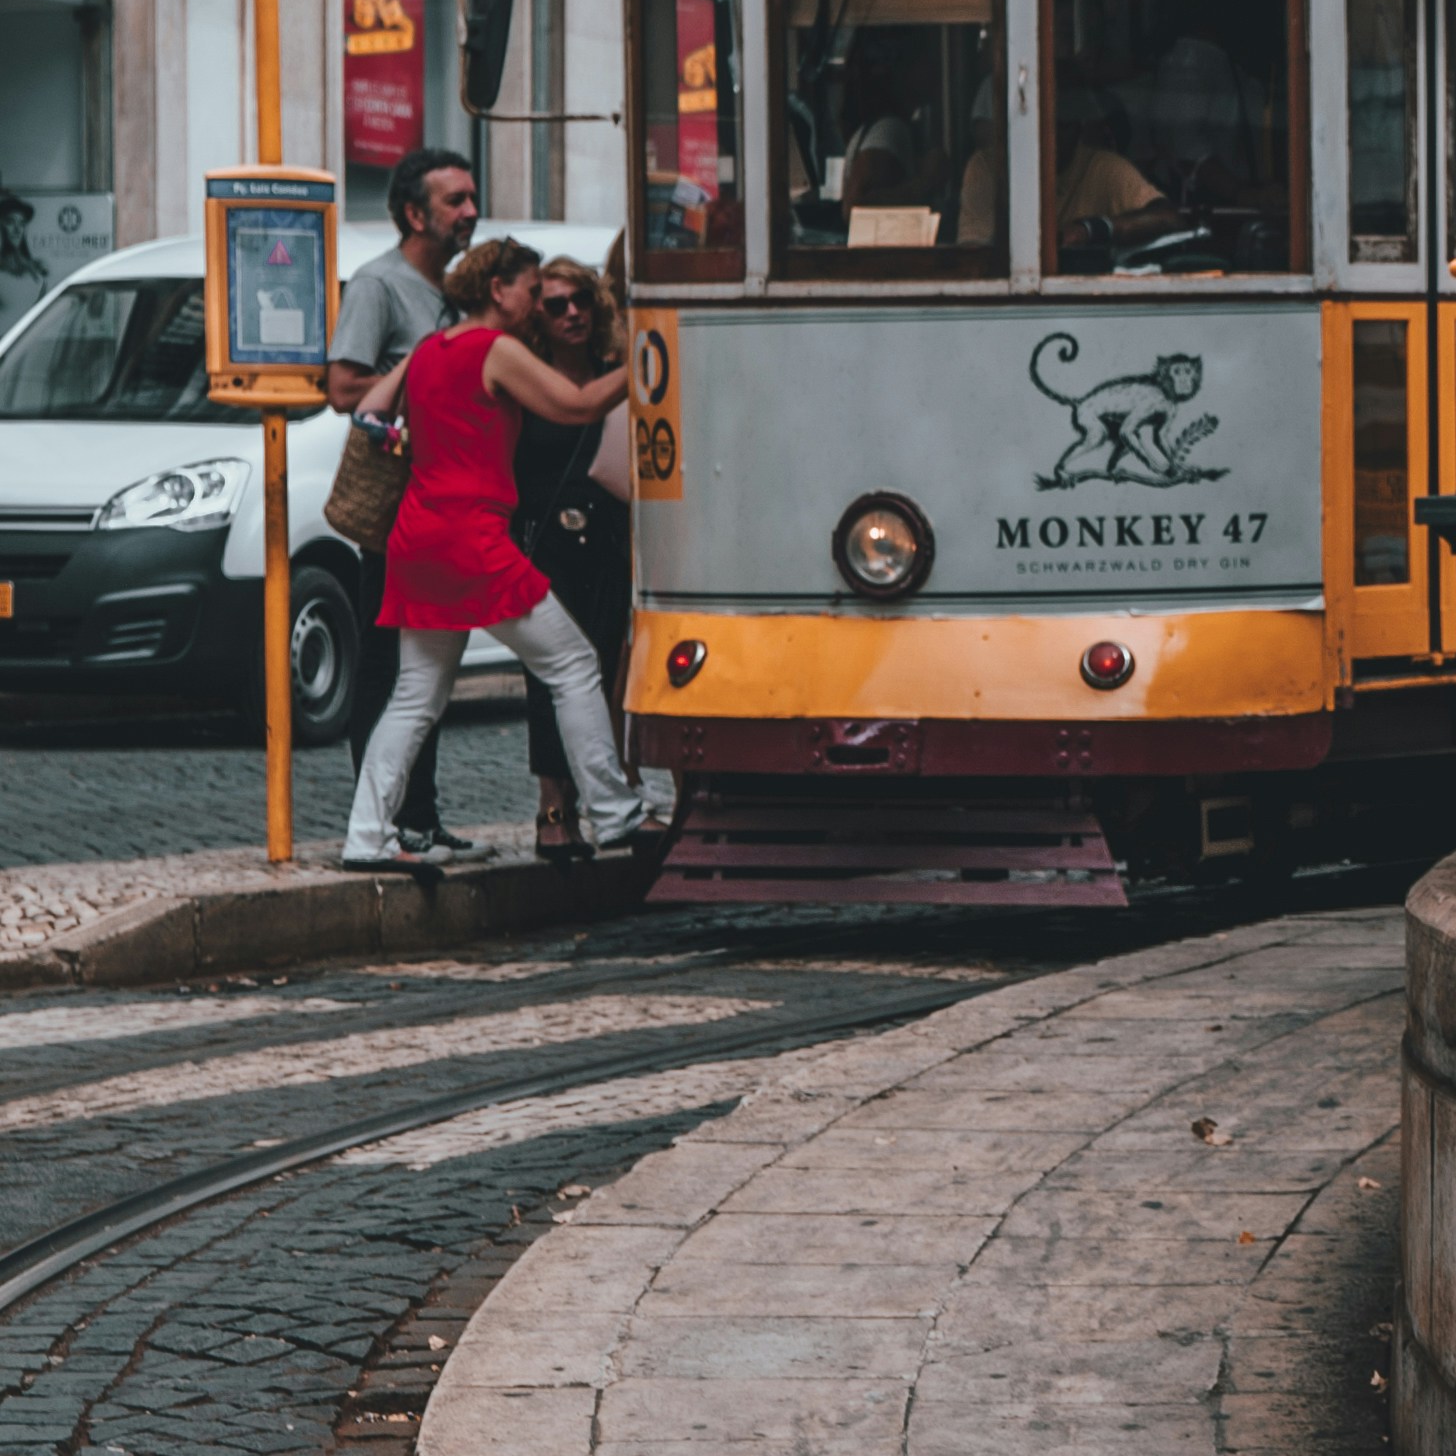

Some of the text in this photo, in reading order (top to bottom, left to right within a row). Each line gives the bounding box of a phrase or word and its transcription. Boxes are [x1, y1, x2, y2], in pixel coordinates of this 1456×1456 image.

[996, 512, 1269, 549] MONKEY 47
[1016, 556, 1250, 575] SCHWARZWALD DRY GIN
